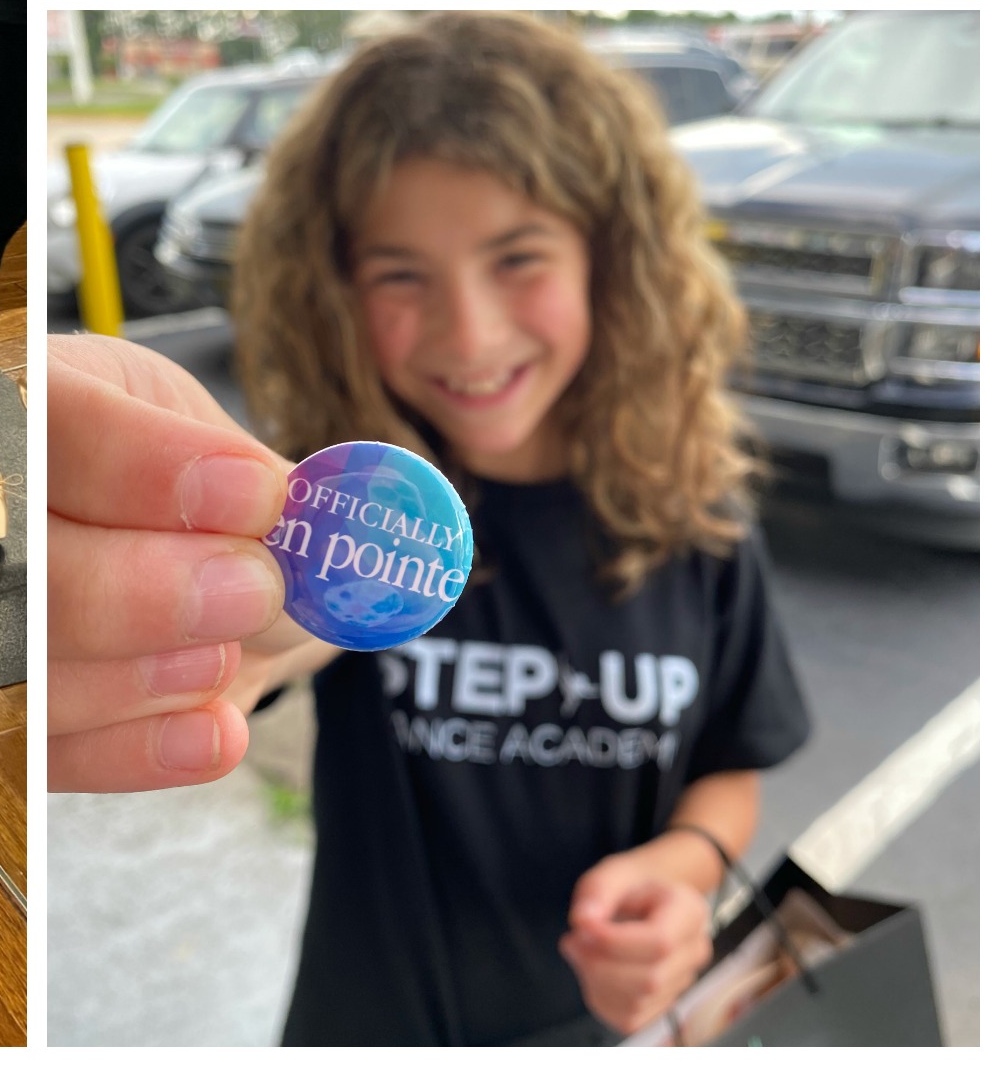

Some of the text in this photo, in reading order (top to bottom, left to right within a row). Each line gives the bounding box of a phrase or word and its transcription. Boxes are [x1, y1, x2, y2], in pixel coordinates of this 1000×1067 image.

[288, 477, 463, 552] OFFICIALLY
[260, 513, 466, 603] en pointe
[599, 649, 700, 727] UP
[390, 708, 499, 766] NCE
